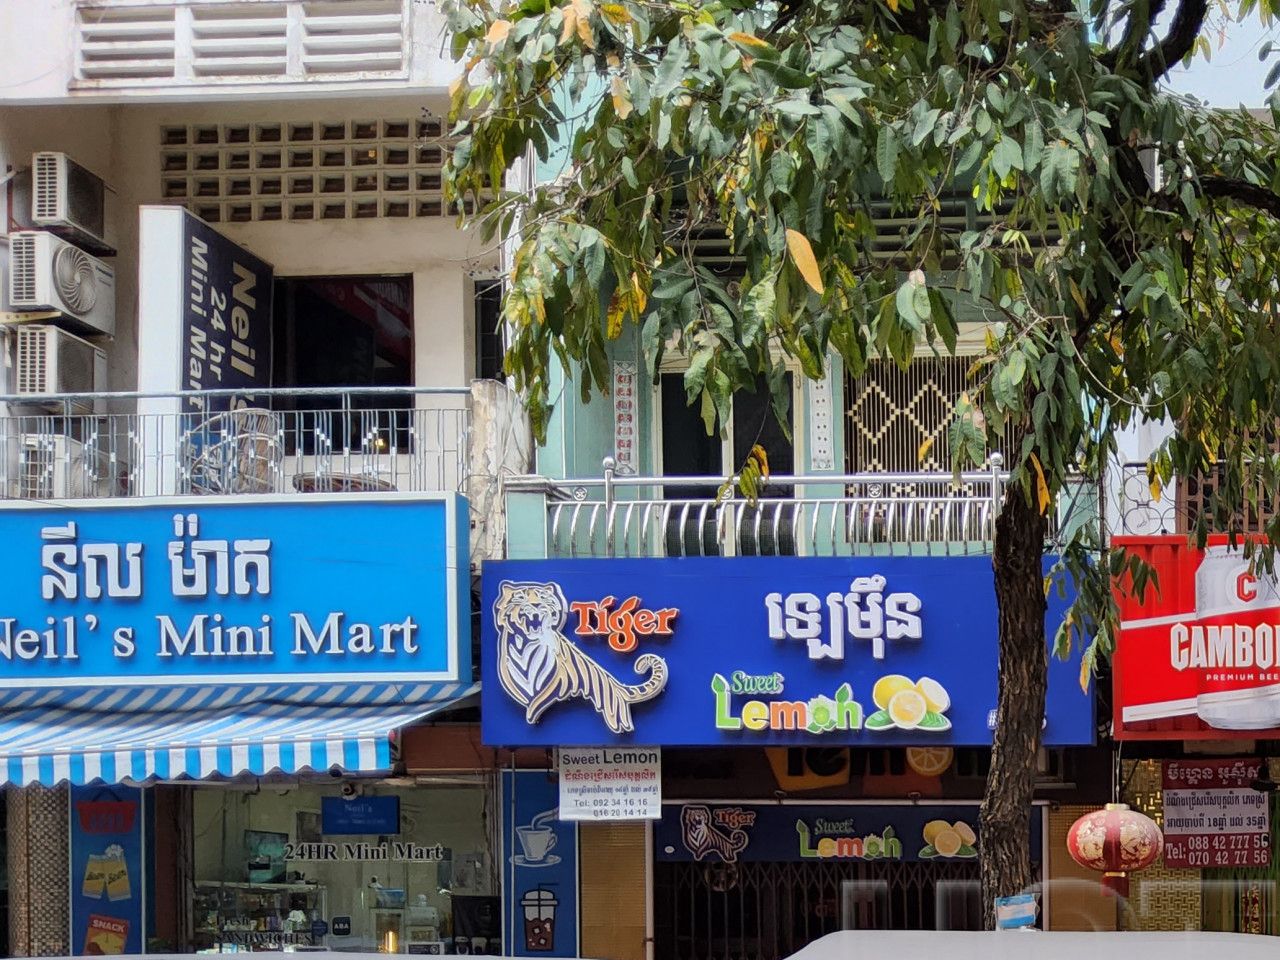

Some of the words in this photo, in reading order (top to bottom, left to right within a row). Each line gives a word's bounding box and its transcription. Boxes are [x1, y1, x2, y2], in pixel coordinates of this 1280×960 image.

[190, 236, 209, 318] Mini
[210, 287, 227, 332] 24
[188, 326, 208, 413] Mart
[209, 341, 226, 382] hr
[155, 613, 273, 657] Mini
[290, 611, 418, 655] Mart
[570, 595, 680, 652] Tiger
[731, 671, 784, 695] Sweet
[711, 673, 863, 734] Lemon
[562, 754, 601, 765] Sweet
[603, 750, 658, 764] Lemon
[574, 799, 590, 807] Tel:
[593, 799, 609, 807] 092
[611, 799, 621, 807] 34
[624, 799, 635, 807] 16
[638, 798, 648, 806] 16
[637, 809, 647, 817] 14
[714, 807, 757, 830] Tiger
[814, 816, 855, 836] Sweet
[796, 818, 903, 861] Lemon
[1188, 836, 1209, 850] 088
[1212, 836, 1226, 849] 42
[1230, 836, 1250, 849] 777
[284, 843, 339, 861] 24HR
[343, 843, 389, 861] Mini
[393, 842, 445, 860] Mart
[1166, 843, 1186, 859] Tel:
[1189, 851, 1209, 865] 070
[1215, 851, 1229, 864] 42
[1235, 851, 1248, 864] 77
[1254, 850, 1268, 864] 56
[92, 919, 126, 933] SNACK
[334, 922, 349, 931] ABA
